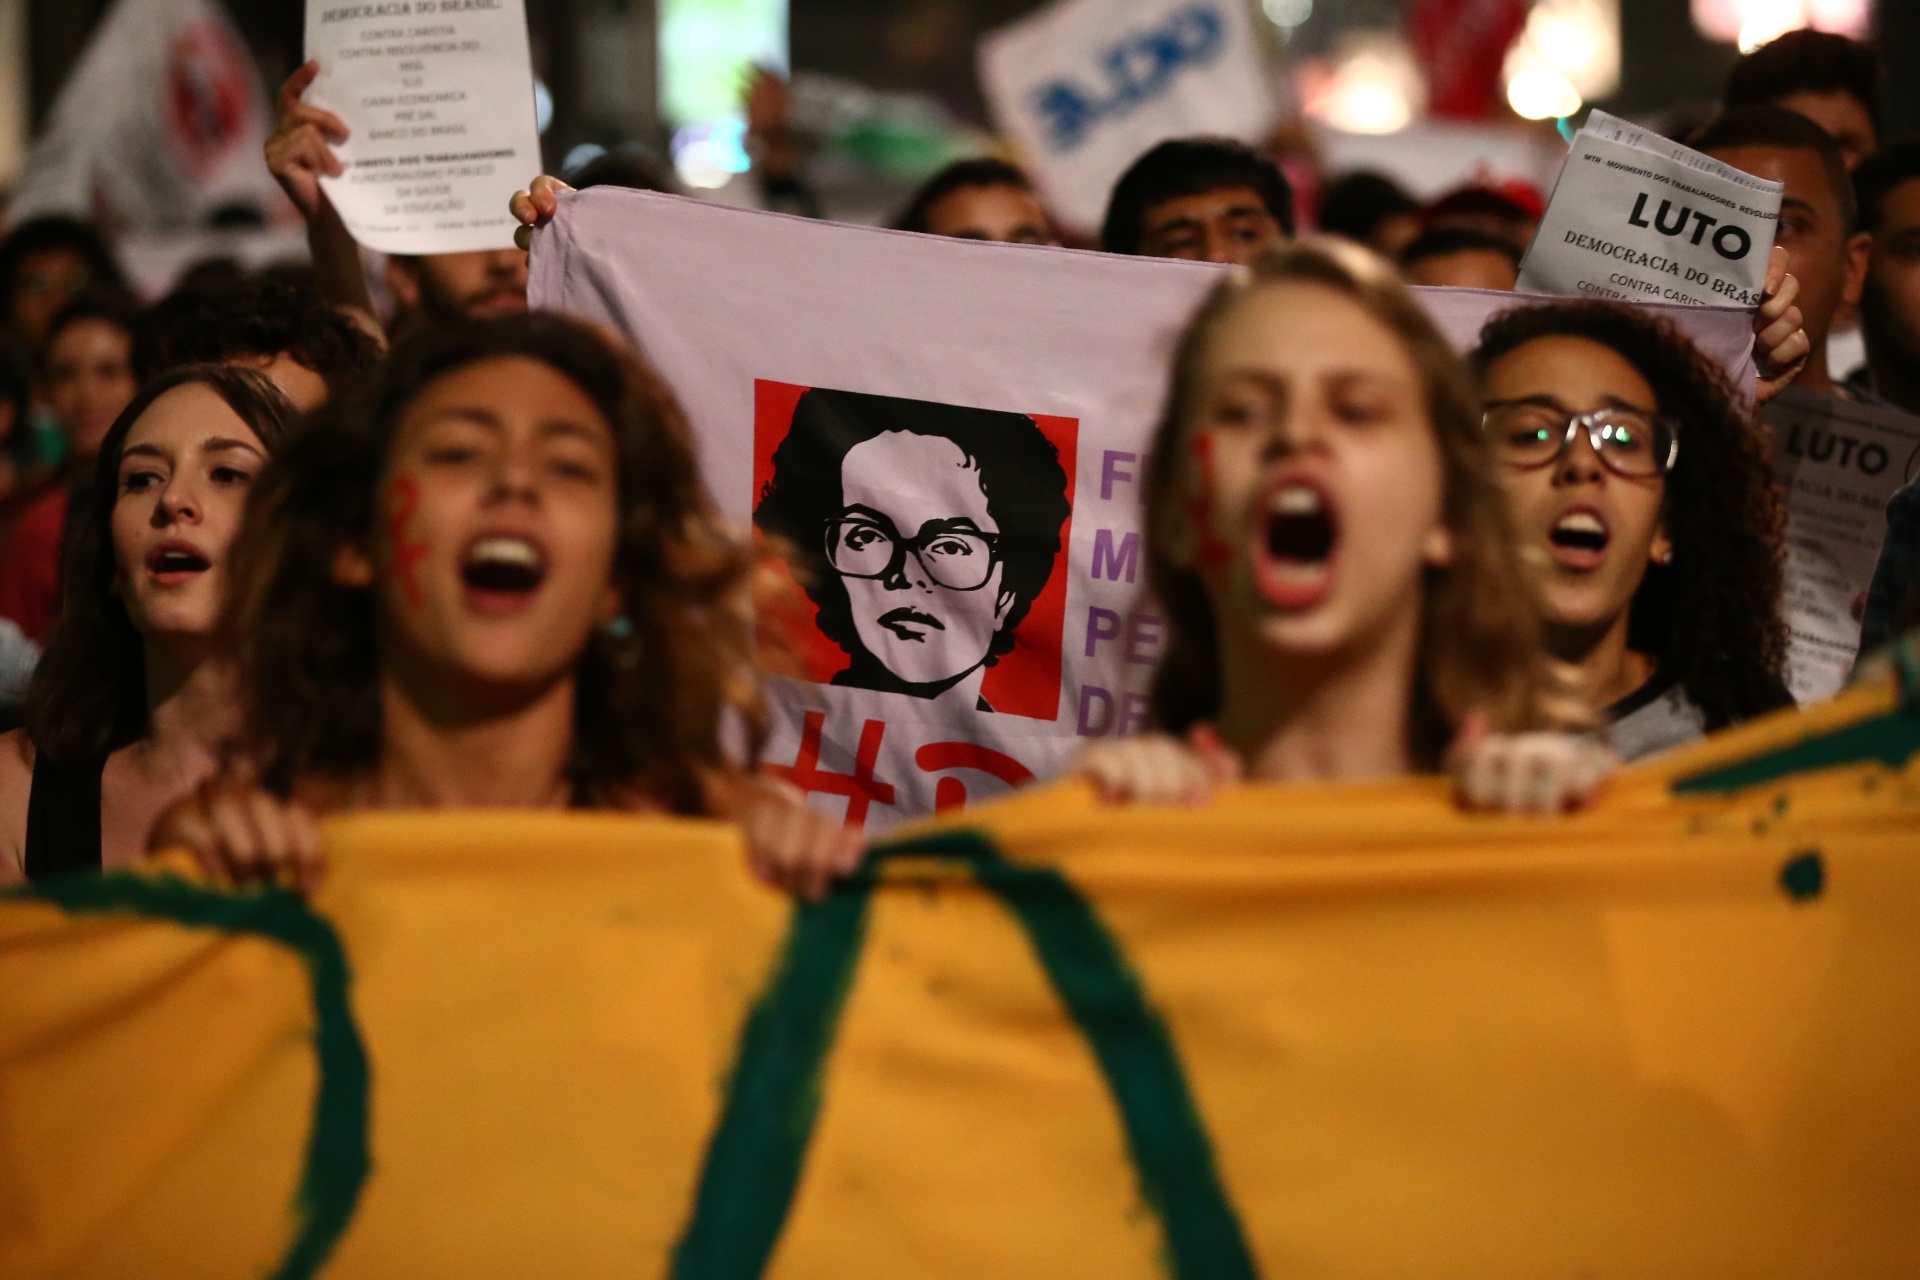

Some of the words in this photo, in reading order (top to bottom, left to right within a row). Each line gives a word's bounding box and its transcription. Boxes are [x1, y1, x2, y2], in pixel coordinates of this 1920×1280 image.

[338, 47, 382, 60] CONTRA
[360, 29, 403, 42] CONTRA
[1606, 160, 1652, 179] MOVIMENTO
[1653, 173, 1670, 185] DOS
[1670, 180, 1736, 209] TRABALHADORES
[1628, 192, 1752, 261] LUTO
[1564, 230, 1679, 276] DEMOCRACIA
[1685, 267, 1709, 286] DO
[1610, 273, 1660, 296] CONTRA
[1785, 424, 1888, 475] LUTO
